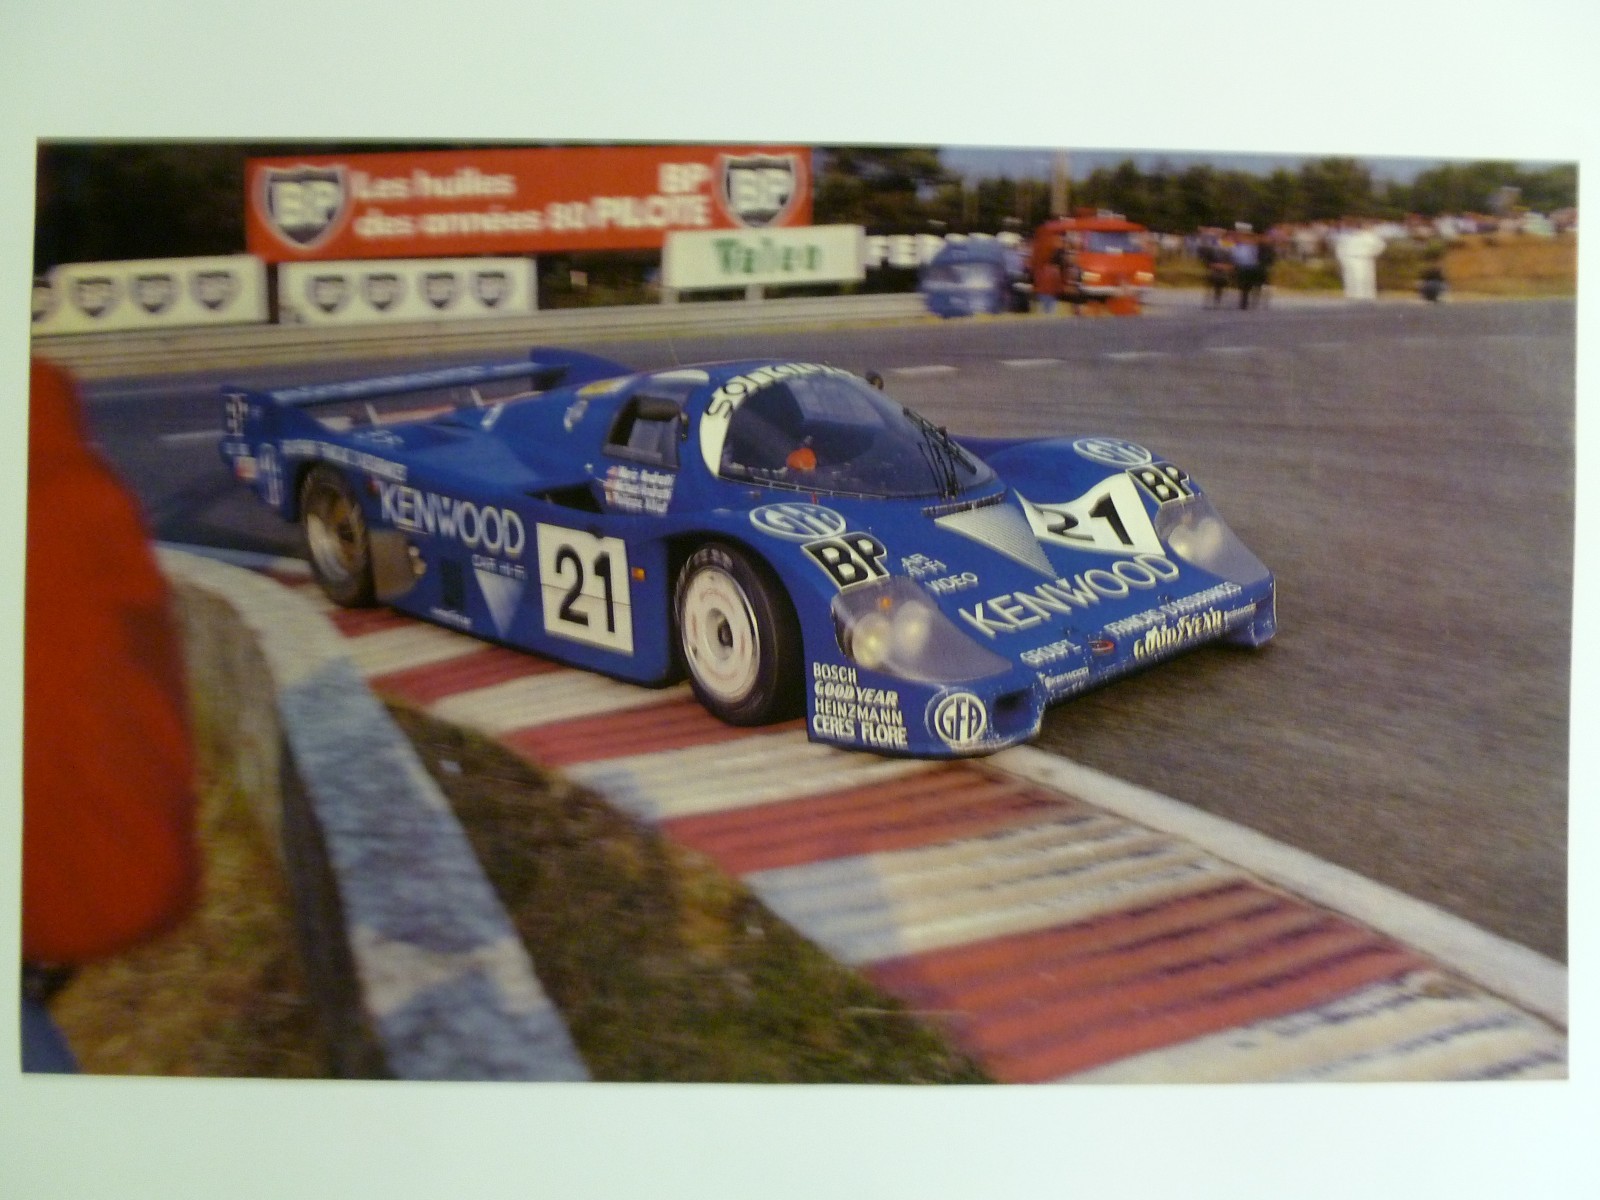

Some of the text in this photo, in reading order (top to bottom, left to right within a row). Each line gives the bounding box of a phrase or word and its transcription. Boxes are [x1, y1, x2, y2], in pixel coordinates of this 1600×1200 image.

[658, 163, 712, 193] BP
[729, 167, 794, 212] BP
[271, 180, 336, 228] BP
[1125, 461, 1195, 504] BP
[379, 481, 526, 556] KENWOOD
[1041, 492, 1135, 546] 21
[803, 532, 890, 591] BP
[924, 572, 978, 592] VIDEO
[555, 543, 616, 633] 21
[958, 553, 1180, 638] KENWOOD
[813, 661, 857, 684] BOSCH
[812, 713, 908, 747] CERES FLORE
[814, 698, 903, 727] HEINZMANN
